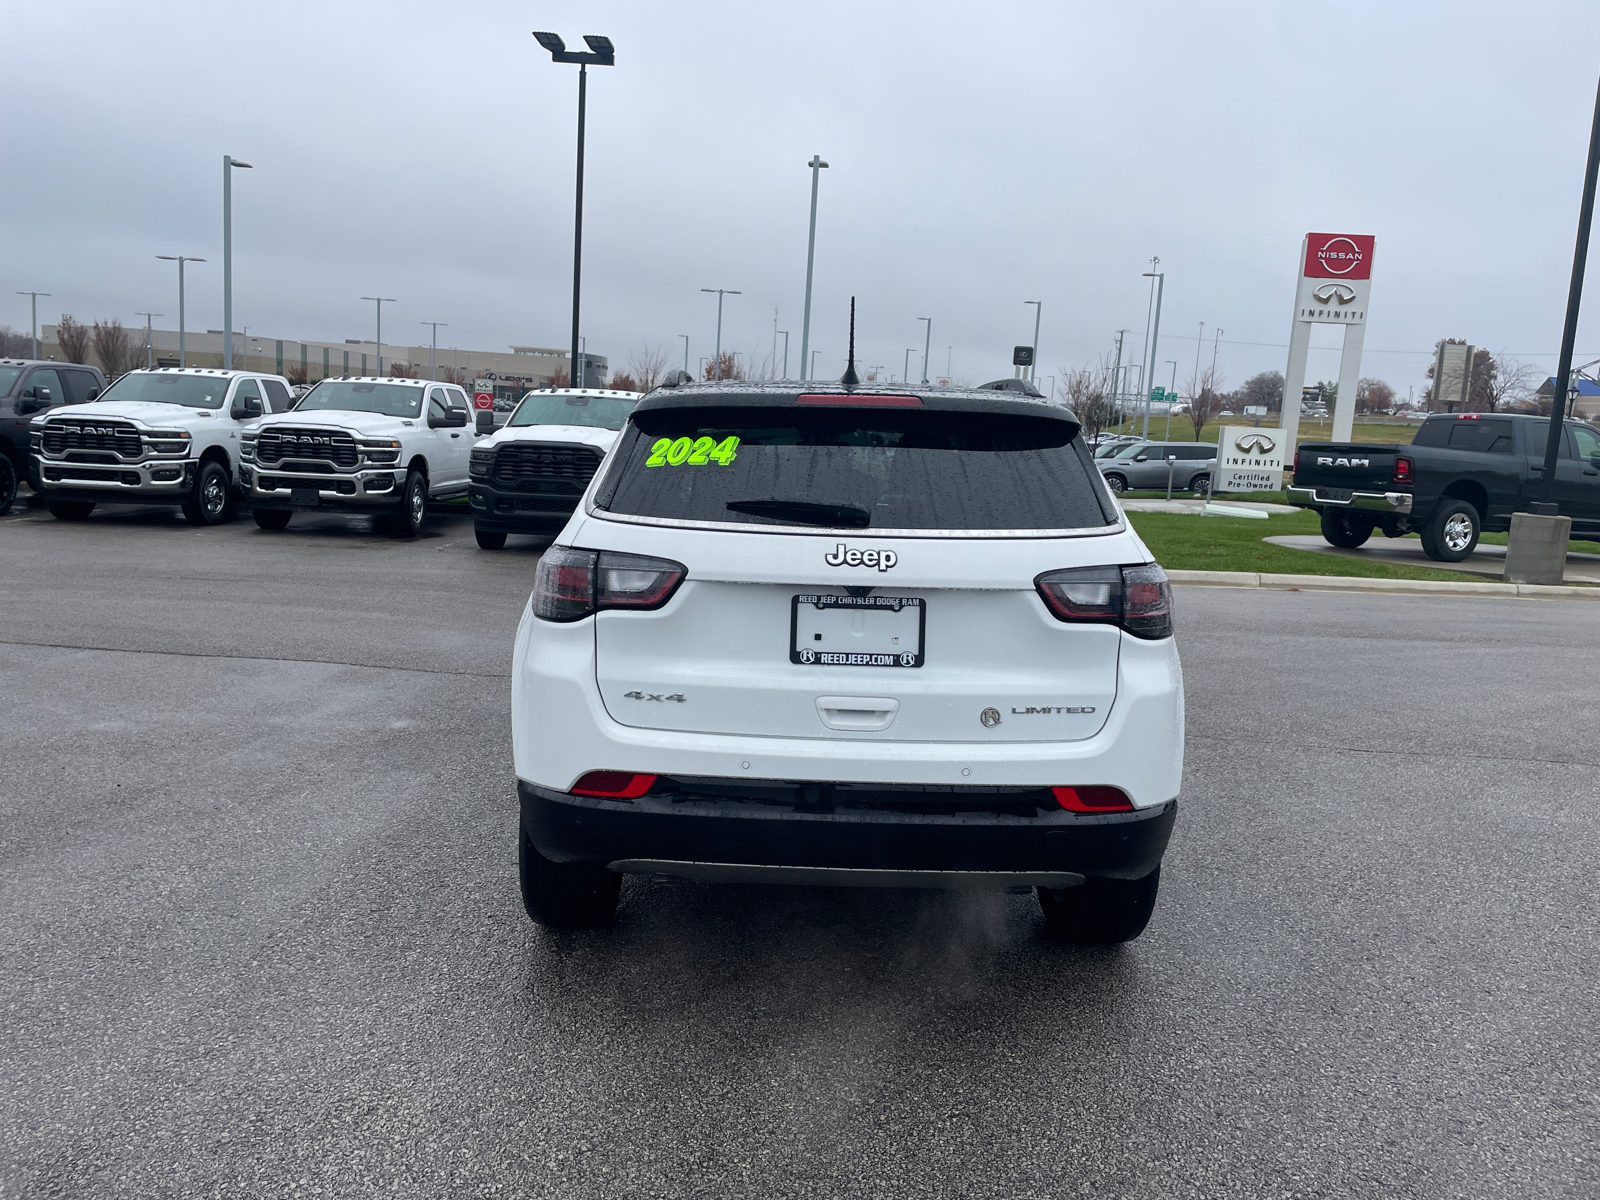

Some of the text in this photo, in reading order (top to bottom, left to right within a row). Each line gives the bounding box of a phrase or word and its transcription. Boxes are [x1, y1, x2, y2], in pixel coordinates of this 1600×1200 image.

[1317, 251, 1362, 260] NISSAN
[1301, 308, 1364, 320] INFINITI
[64, 426, 114, 436] RAM
[281, 436, 330, 445] RAM
[645, 436, 740, 467] 2024
[1226, 457, 1280, 467] INFINITI
[1316, 457, 1370, 468] RAM
[1233, 473, 1270, 482] Certified
[1227, 481, 1274, 490] Pre-Owned
[825, 543, 898, 572] Jeep
[799, 595, 920, 606] REED JEEP CHRYSLER DODGE RAM
[820, 653, 894, 666] REEDJEEP.COM
[1011, 706, 1096, 715] LIMITED
